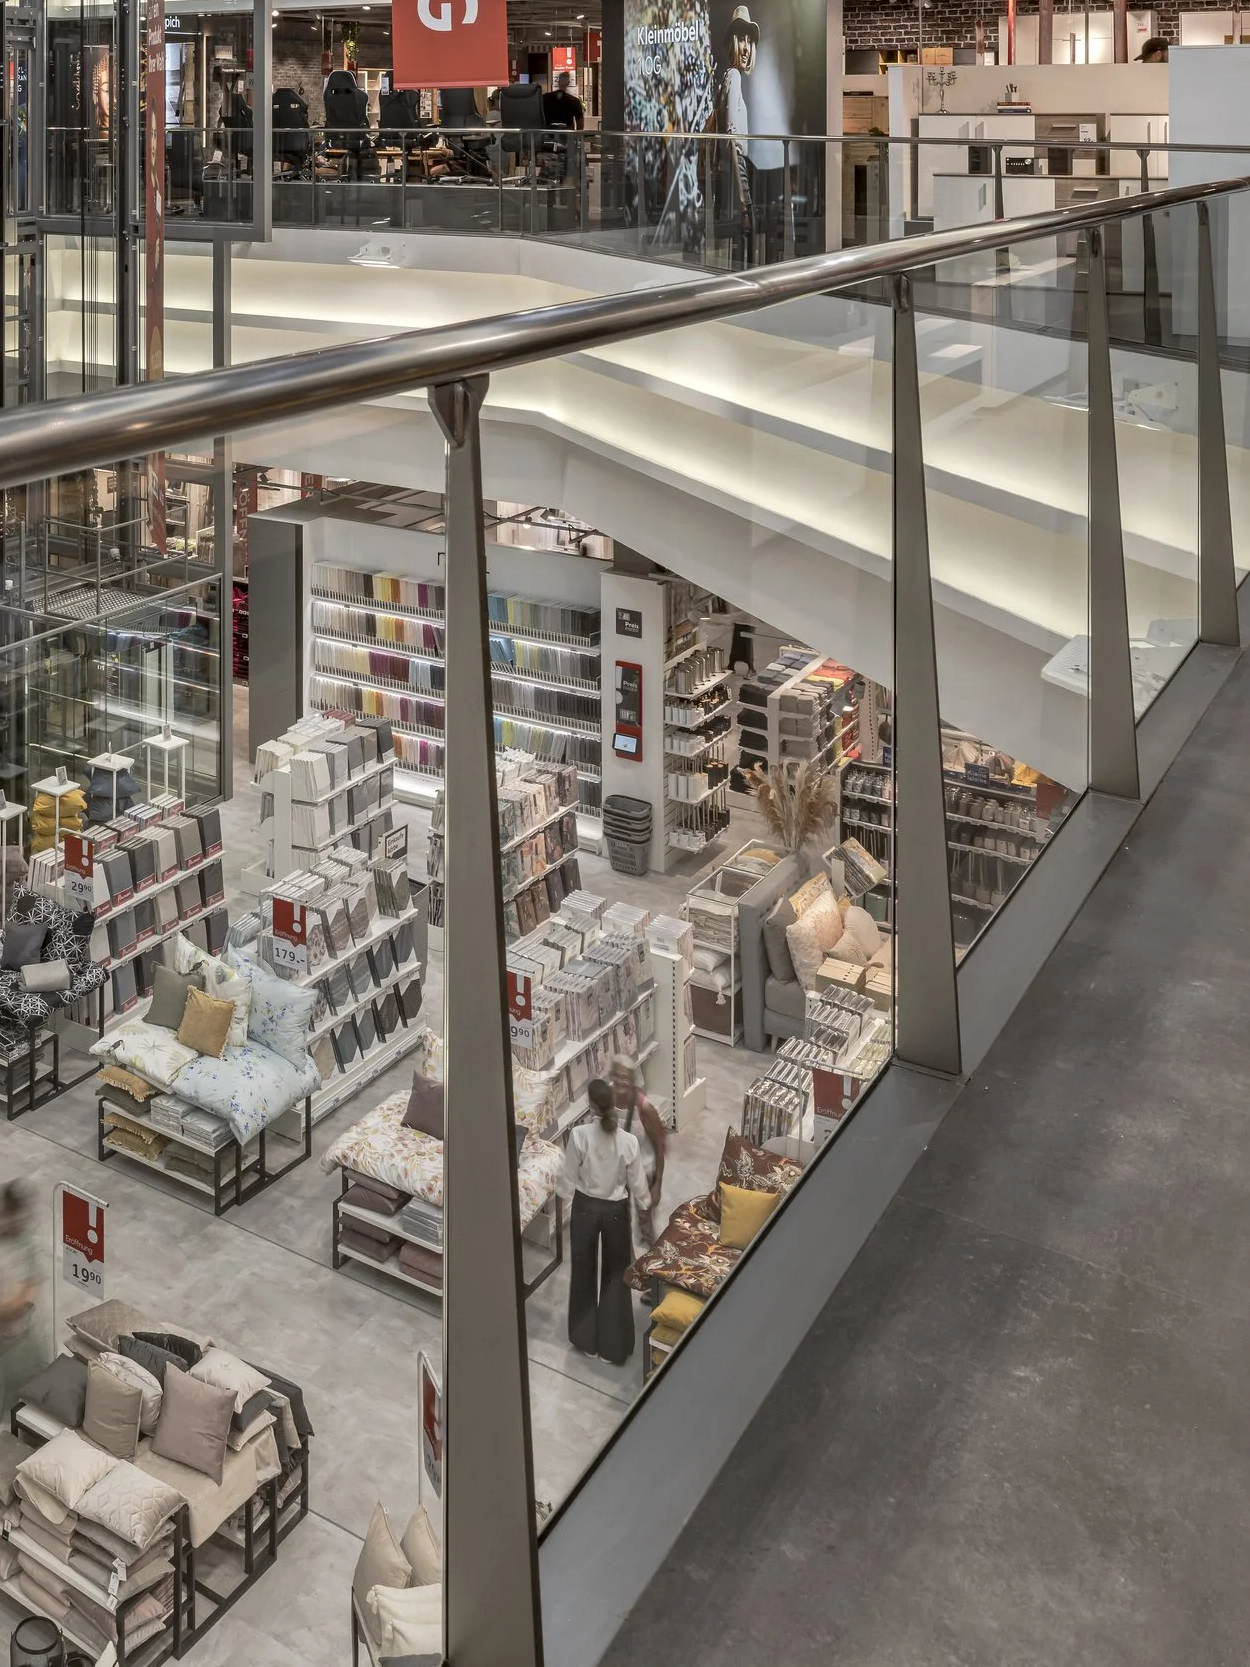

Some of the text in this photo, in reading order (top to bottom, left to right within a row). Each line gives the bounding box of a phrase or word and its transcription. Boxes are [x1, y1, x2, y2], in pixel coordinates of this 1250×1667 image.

[637, 20, 699, 46] Kleinmöbel
[638, 55, 662, 75] 1.OG
[624, 621, 639, 629] Preis
[622, 680, 638, 689] Preis
[274, 946, 306, 964] 179.-
[65, 1234, 93, 1256] Eröffnung
